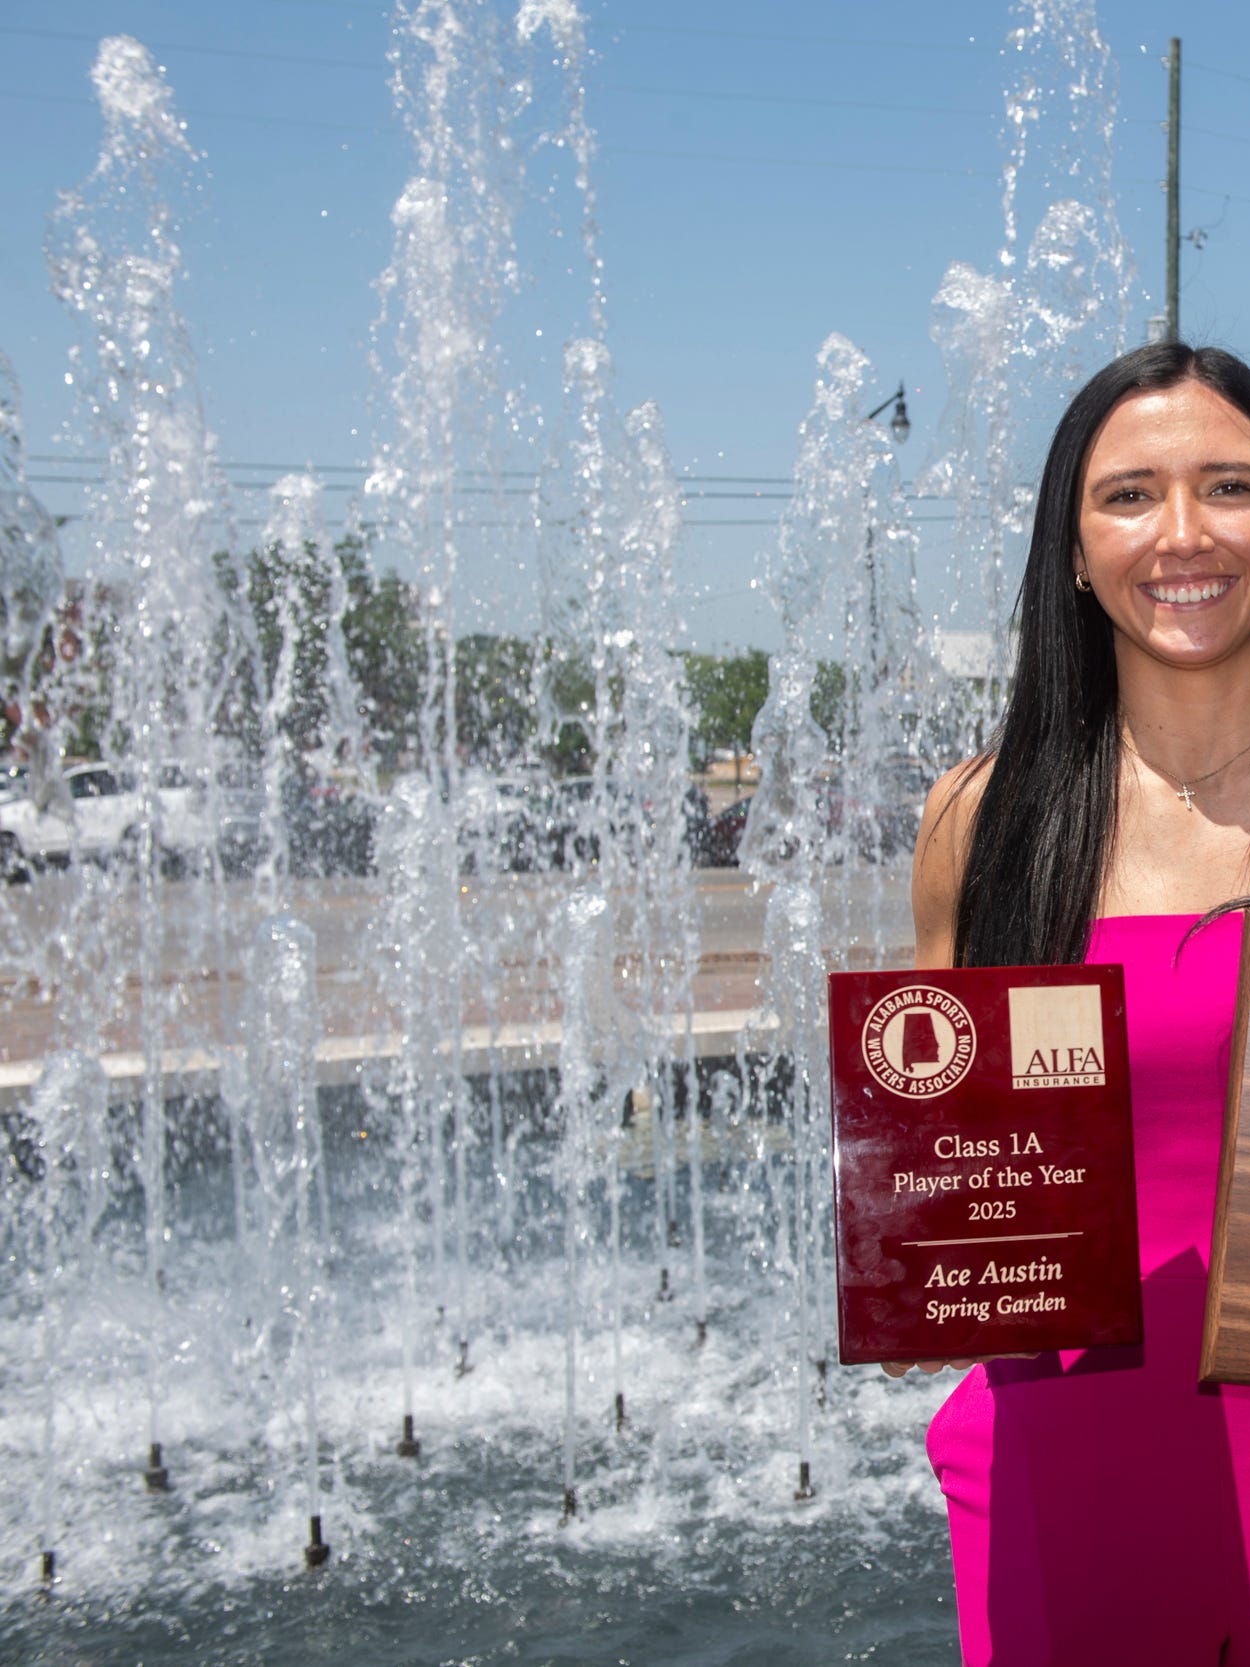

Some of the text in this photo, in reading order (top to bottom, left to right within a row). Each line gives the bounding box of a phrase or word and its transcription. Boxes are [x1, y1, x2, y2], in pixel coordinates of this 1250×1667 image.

[870, 991, 968, 1032] ALABAMA SPORTS
[867, 1035, 971, 1093] WRITERS ASSOCIATION
[1025, 1047, 1104, 1074] ALFA
[1017, 1076, 1100, 1088] INSURANCE
[934, 1132, 1044, 1159] Class 1A
[893, 1165, 1086, 1198] Player of the Year
[968, 1200, 1017, 1221] 2025
[924, 1255, 1063, 1288] Ace Austin
[926, 1291, 1066, 1324] Spring Garden
